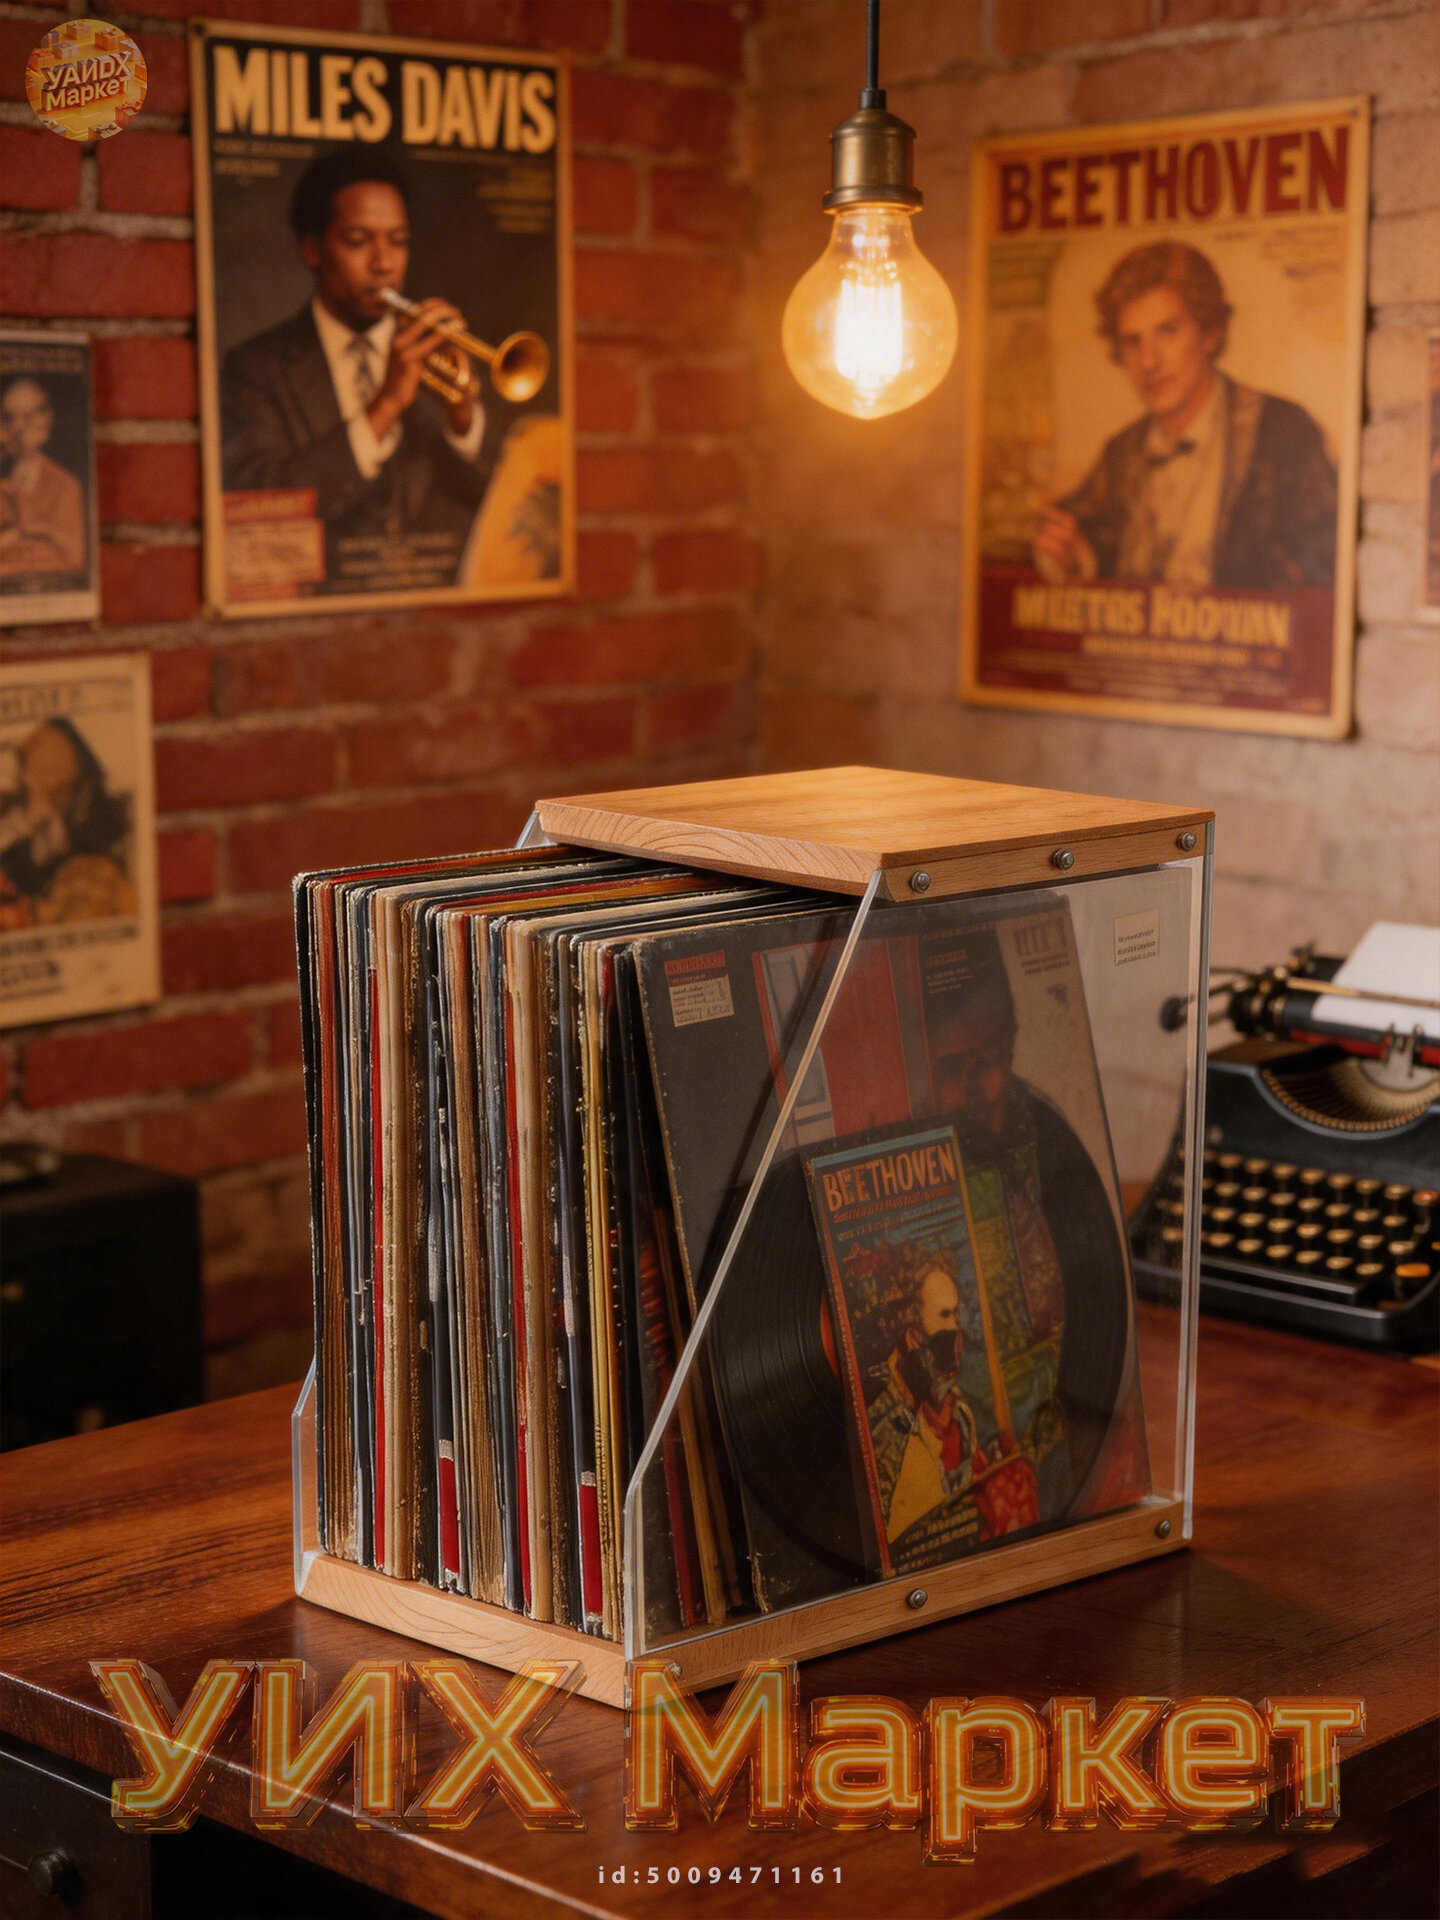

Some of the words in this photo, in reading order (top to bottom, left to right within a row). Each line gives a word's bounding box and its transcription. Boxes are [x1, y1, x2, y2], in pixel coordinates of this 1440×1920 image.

[213, 45, 393, 144] MILES
[402, 61, 557, 154] DAVIS
[1000, 126, 1350, 234] BEETHOVEN
[822, 1143, 957, 1212] BEETHOVEN
